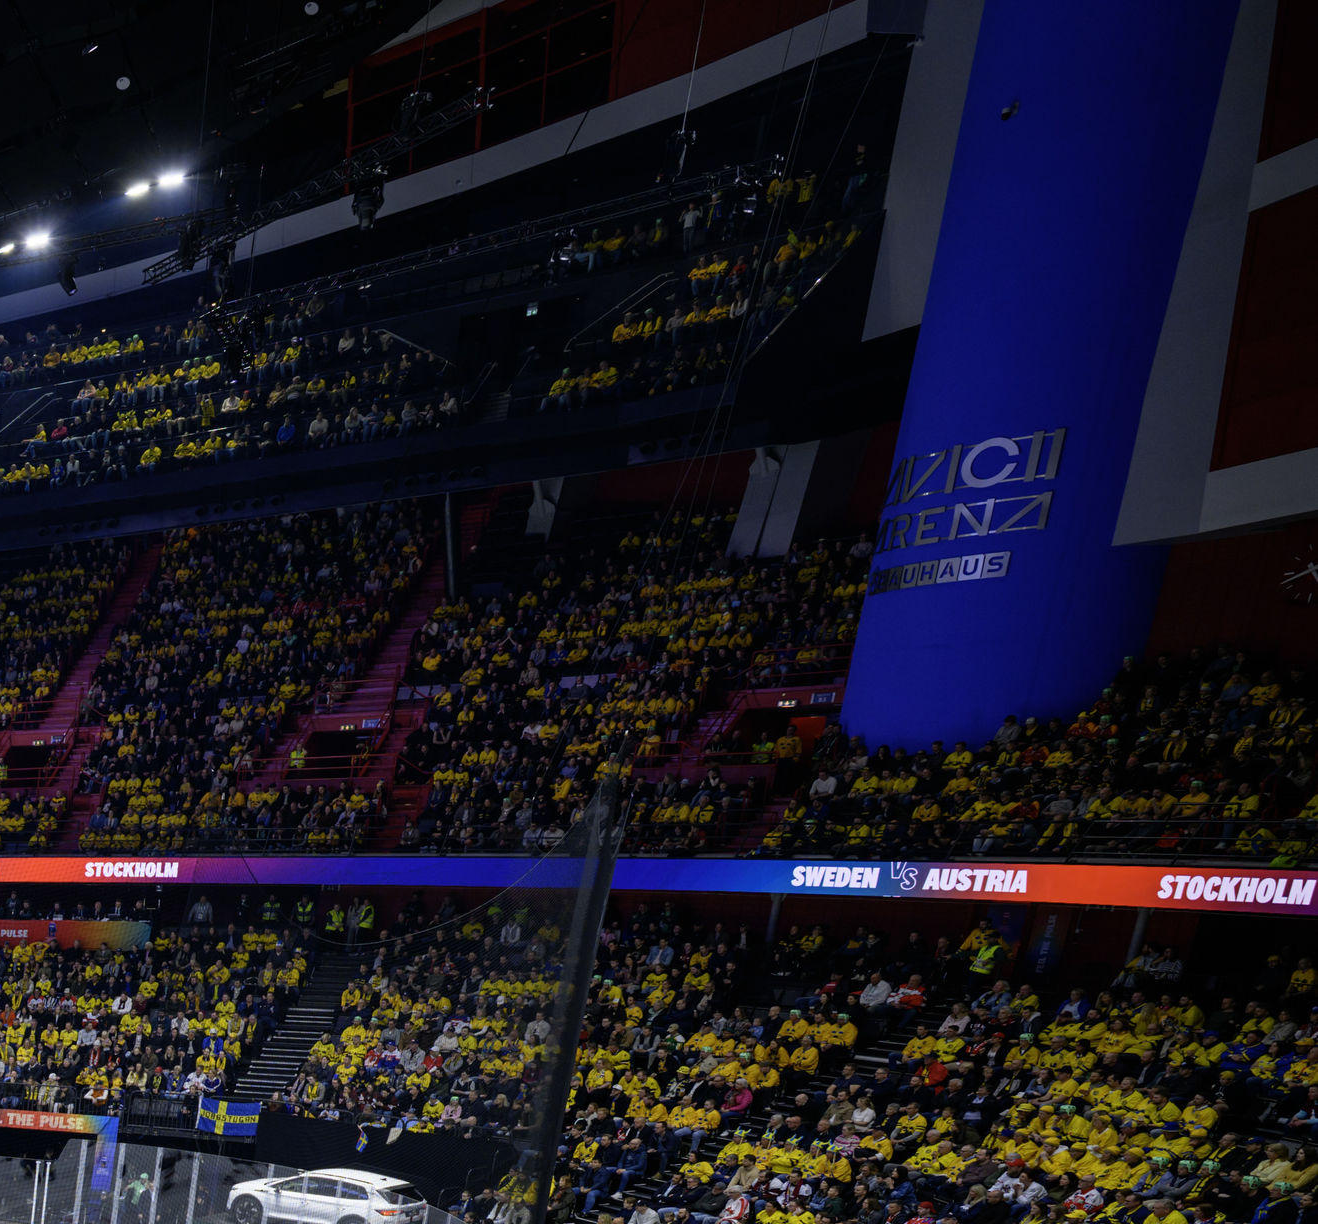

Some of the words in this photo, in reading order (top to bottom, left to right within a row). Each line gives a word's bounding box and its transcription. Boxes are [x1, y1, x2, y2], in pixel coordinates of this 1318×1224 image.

[84, 862, 179, 878] STOCKHOLM
[791, 866, 880, 888] SWEDEN
[890, 862, 918, 890] VS
[922, 869, 1028, 893] AUSTRIA
[1157, 874, 1317, 905] STOCKHOLM
[0, 929, 28, 938] PULSE
[7, 1110, 35, 1127] THE
[39, 1112, 84, 1131] PULSE
